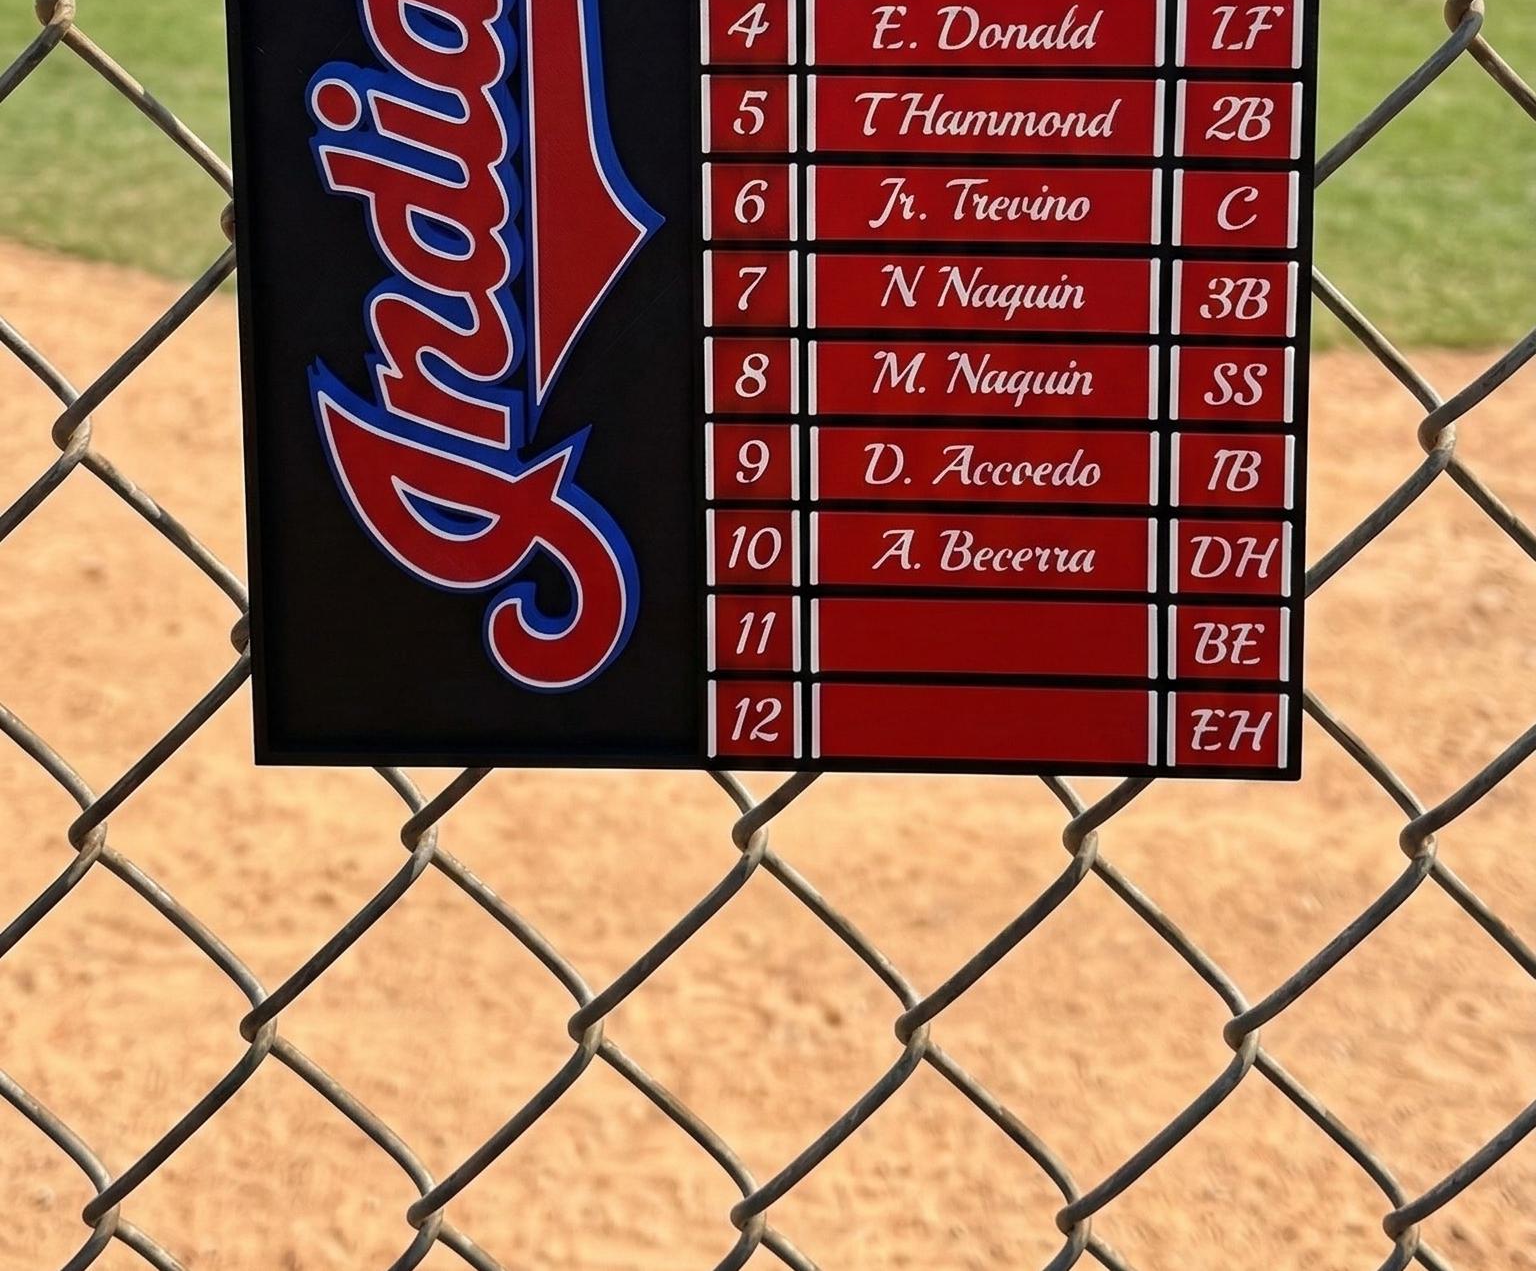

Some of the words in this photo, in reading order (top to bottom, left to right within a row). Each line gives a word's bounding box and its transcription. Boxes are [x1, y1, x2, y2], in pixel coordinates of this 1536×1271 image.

[728, 3, 769, 48] 4
[872, 6, 917, 48] E.
[938, 5, 1103, 49] Donald
[1212, 6, 1284, 49] LF
[734, 91, 767, 134] 5
[855, 93, 897, 135] T
[899, 93, 1119, 137] Hammond
[1206, 97, 1273, 141] 2B
[735, 180, 768, 223] 6
[869, 178, 926, 228] Jr.
[946, 179, 1090, 220] Trevino
[1218, 187, 1258, 230] C
[738, 267, 767, 310] 7
[881, 265, 925, 307] N
[938, 266, 1085, 321] Naquin
[1200, 278, 1270, 319] 3B
[735, 353, 769, 397] 8
[873, 351, 925, 393] M.
[947, 352, 1093, 408] Naquin
[1204, 363, 1267, 405] SS
[739, 440, 769, 483] 9
[729, 526, 781, 569] 10
[872, 530, 920, 569] A.
[940, 530, 1095, 572] Becerra
[1191, 536, 1279, 578] DH
[737, 612, 775, 654] 11
[1194, 623, 1264, 664] BE
[732, 698, 781, 741] 12
[1192, 709, 1272, 751] EH
